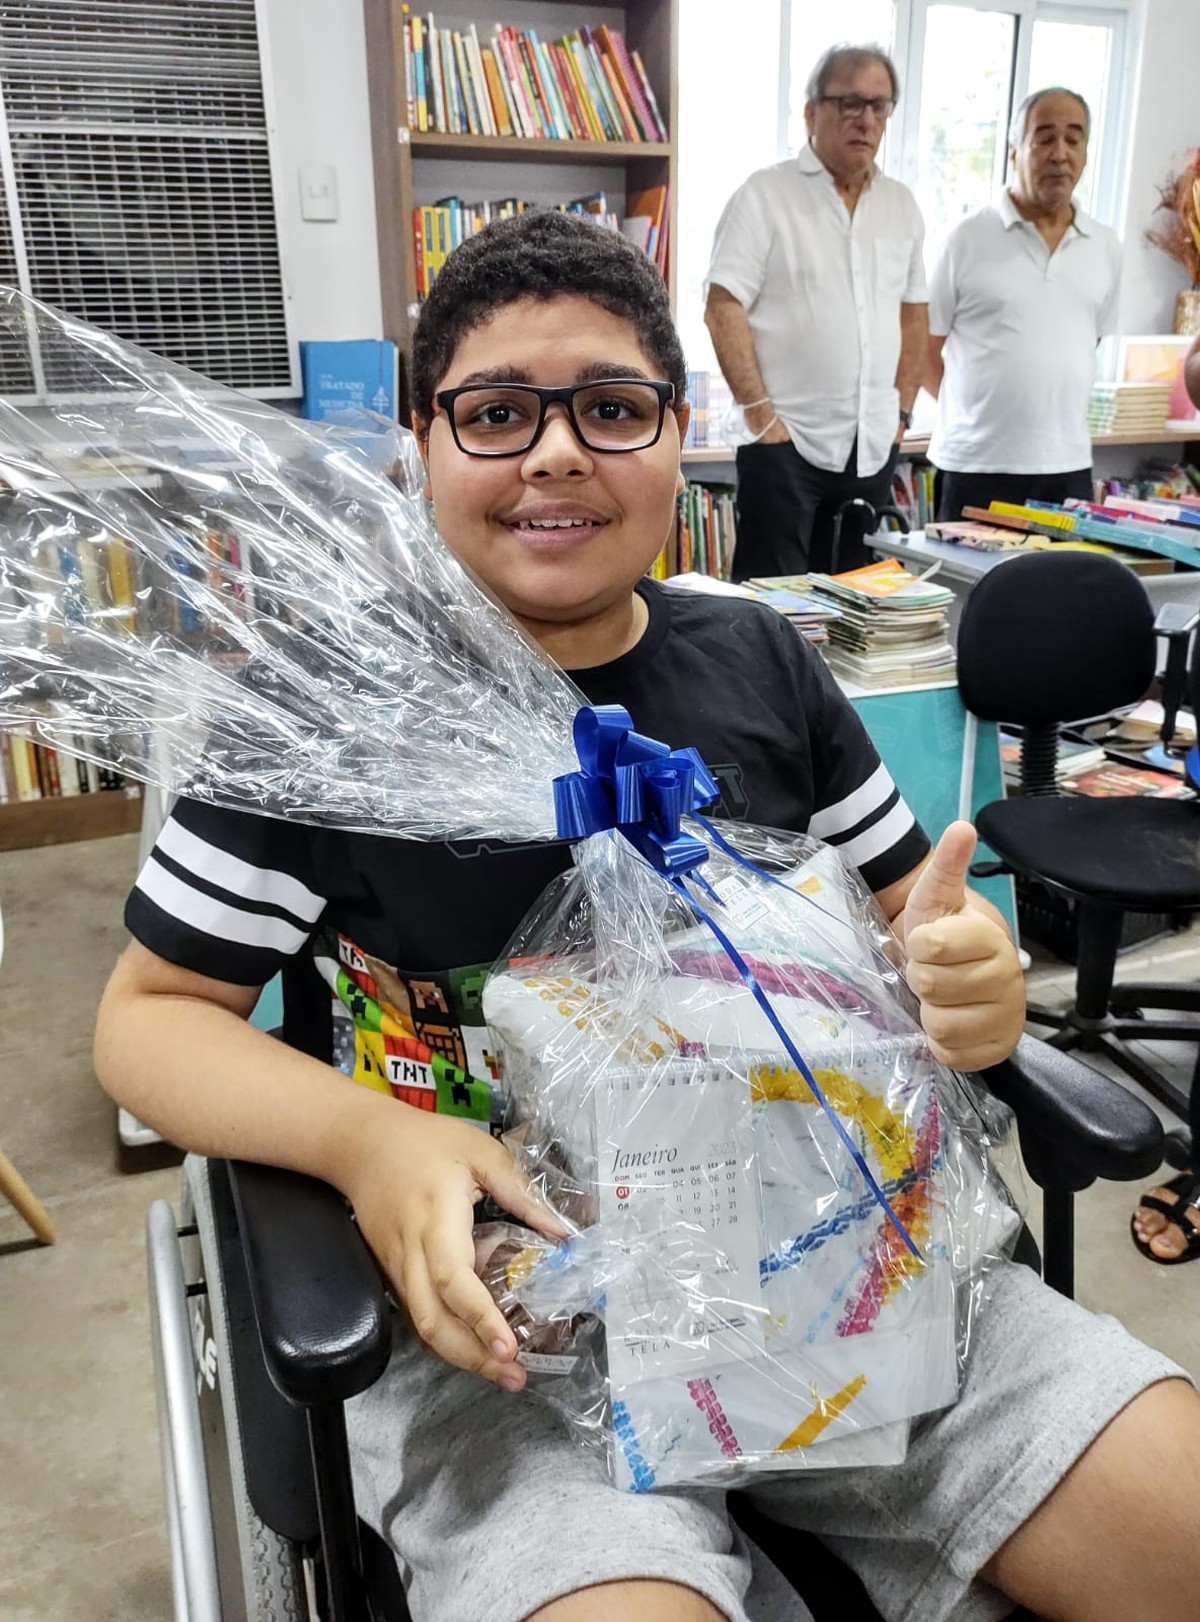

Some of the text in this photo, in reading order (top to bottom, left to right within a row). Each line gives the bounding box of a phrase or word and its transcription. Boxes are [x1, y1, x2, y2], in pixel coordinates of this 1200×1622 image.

[612, 1143, 678, 1174] Janeiro
[671, 1167, 685, 1175] QUA
[690, 1176, 702, 1186] 05
[708, 1173, 720, 1183] 06
[726, 1171, 736, 1180] 07
[676, 1194, 682, 1203] 11
[693, 1192, 701, 1201] 12
[728, 1185, 736, 1194] 14
[728, 1200, 737, 1209] 21
